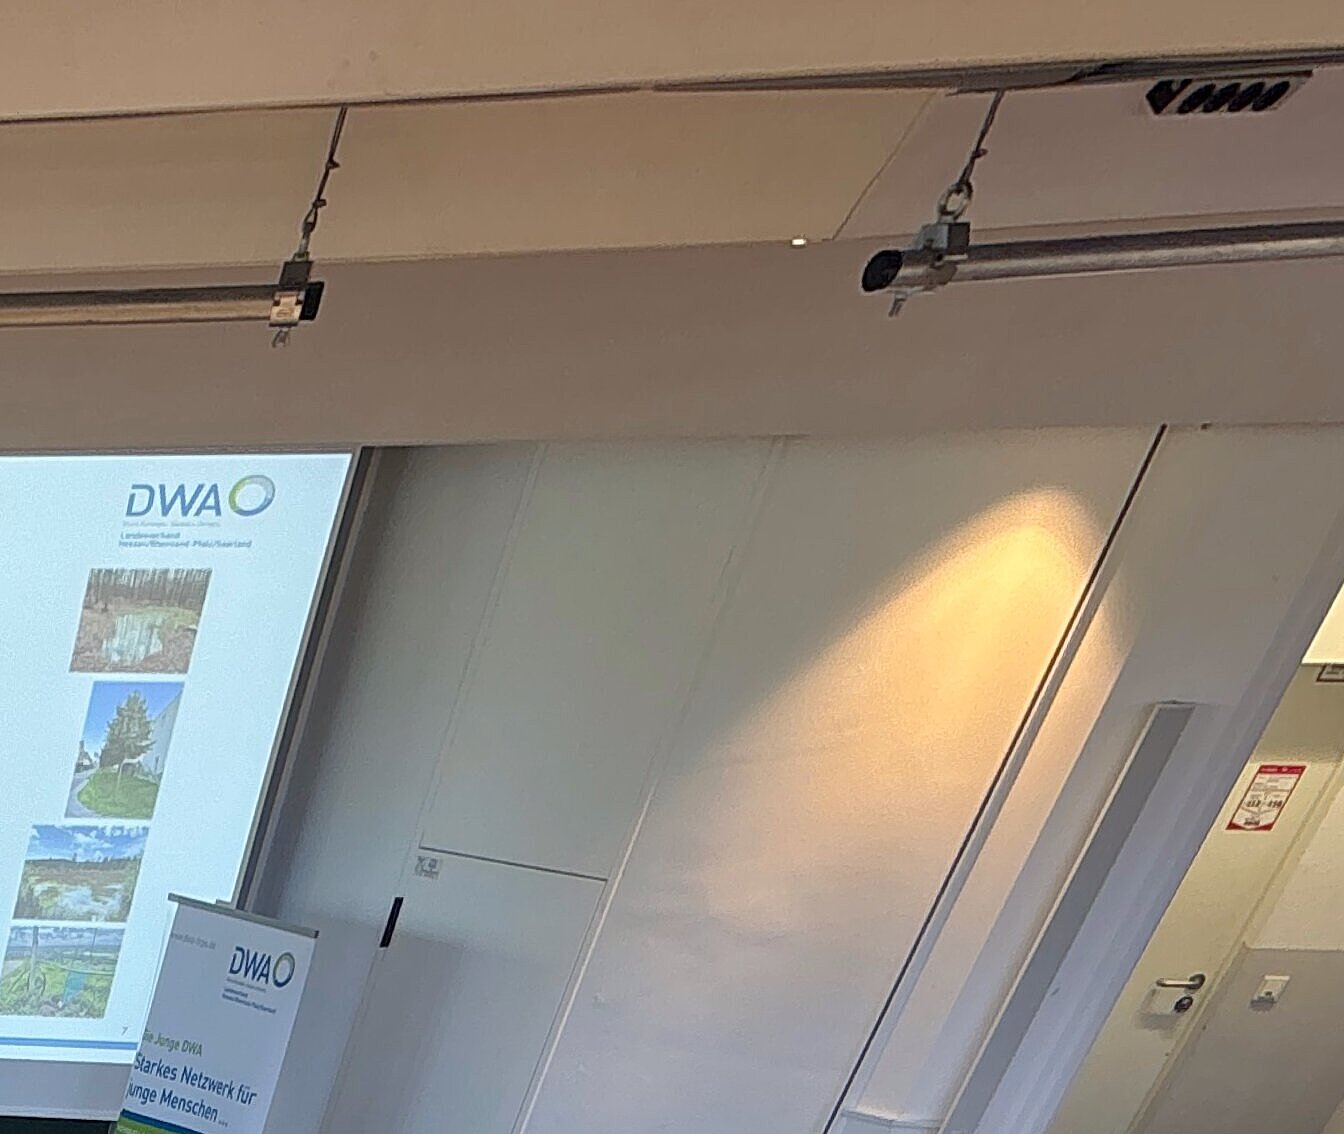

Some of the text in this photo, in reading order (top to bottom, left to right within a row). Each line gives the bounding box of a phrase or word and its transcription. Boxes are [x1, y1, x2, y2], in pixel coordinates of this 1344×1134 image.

[126, 483, 221, 517] DWA
[229, 946, 271, 983] DWA
[182, 1039, 203, 1057] DWA
[135, 1051, 257, 1105] Starkes Netzwerk für
[160, 1087, 219, 1123] Menschen
